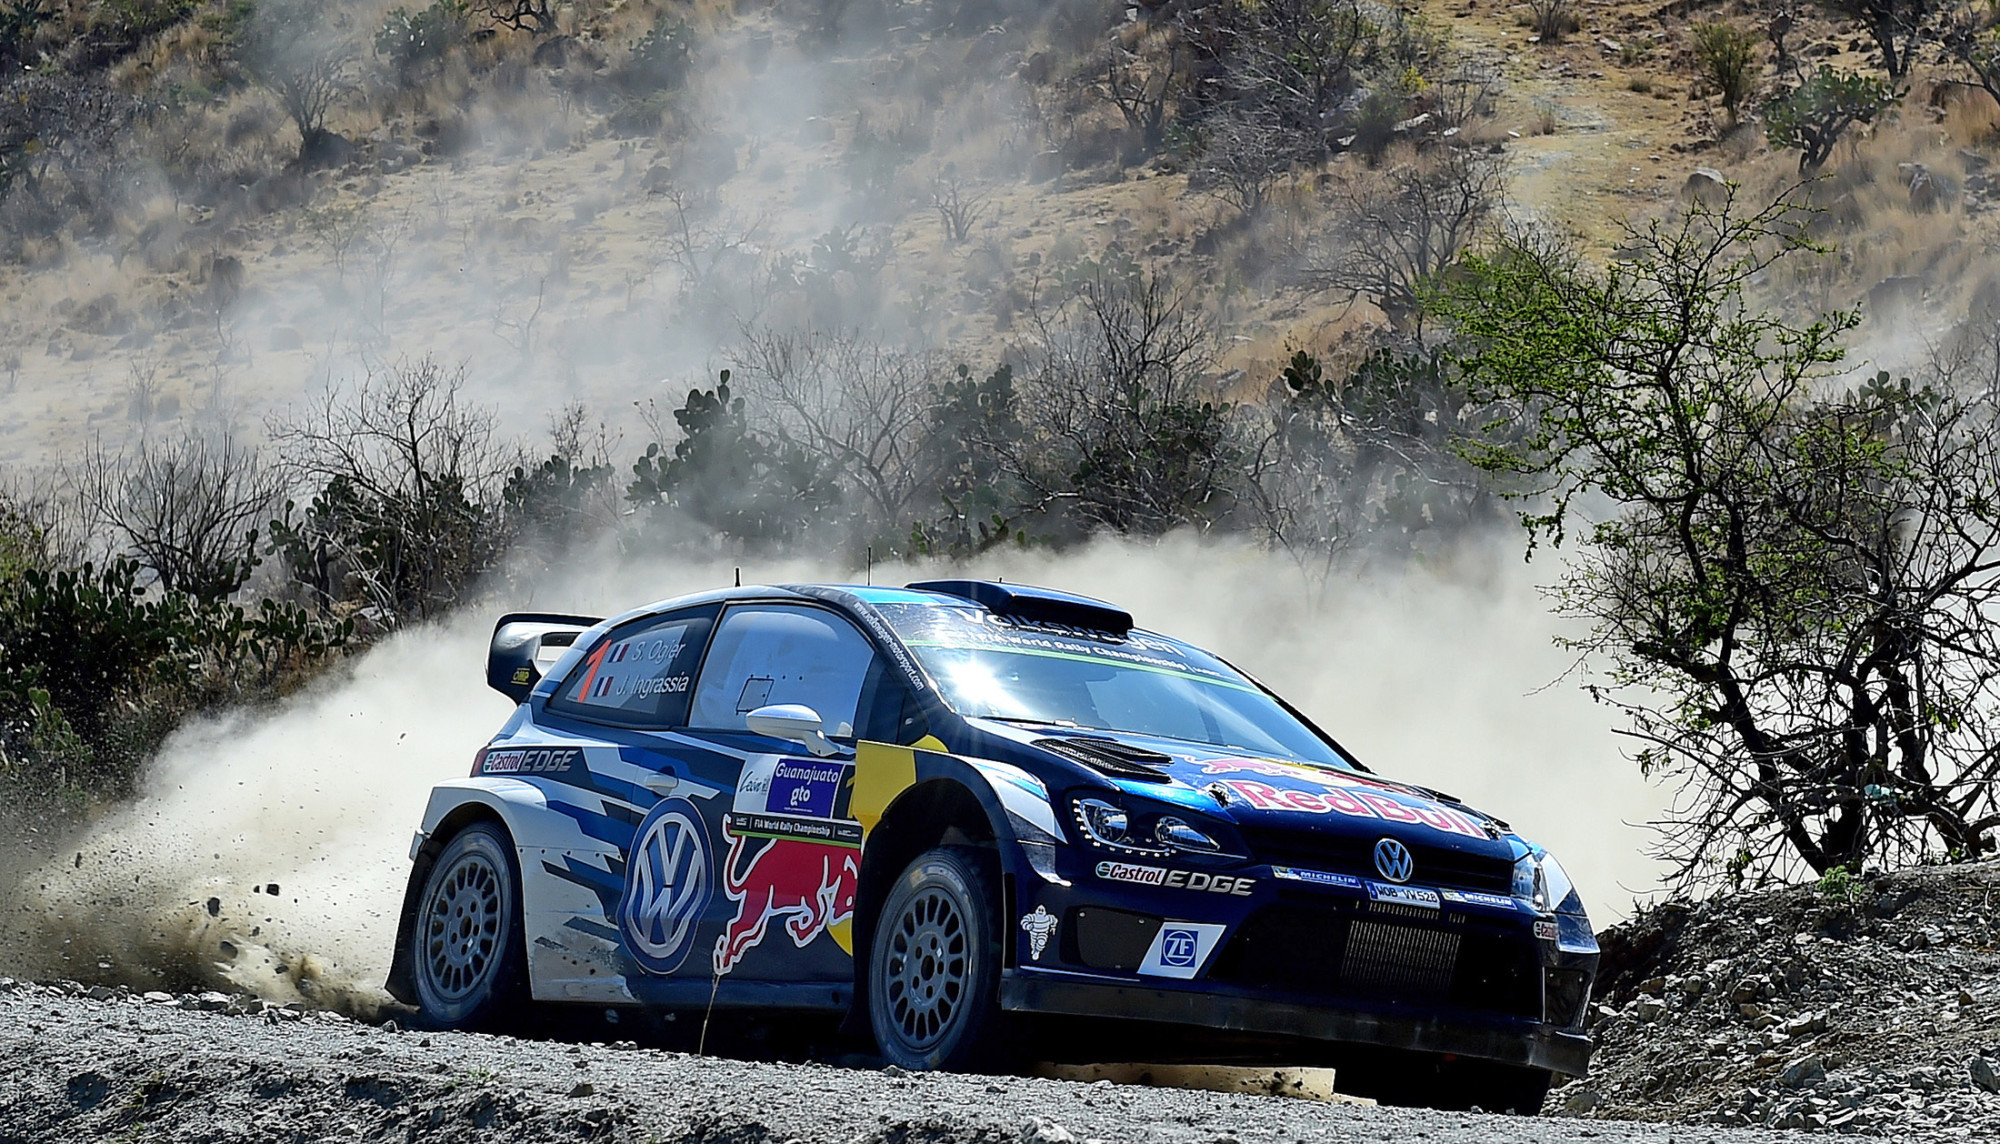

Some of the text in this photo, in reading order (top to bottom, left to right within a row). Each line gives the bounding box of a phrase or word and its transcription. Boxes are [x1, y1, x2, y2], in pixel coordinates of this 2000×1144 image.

[631, 640, 687, 665] S. Ogier
[1007, 636, 1052, 648] World
[1053, 641, 1091, 654] Rally
[578, 639, 612, 703] 1
[616, 672, 690, 699] J. Ingrassia
[490, 750, 579, 772] Castrol EDGE
[775, 762, 839, 786] Guanajuato
[790, 785, 811, 807] gto
[754, 818, 763, 829] FIA
[764, 820, 780, 831] World
[780, 821, 793, 834] Rally
[793, 823, 830, 837] Championship
[1109, 864, 1257, 896] Castrol EDGE
[1300, 871, 1356, 884] MICHELIN
[1375, 885, 1398, 898] WOB
[1464, 893, 1512, 906] MICHELIN
[1165, 937, 1194, 960] ZF
